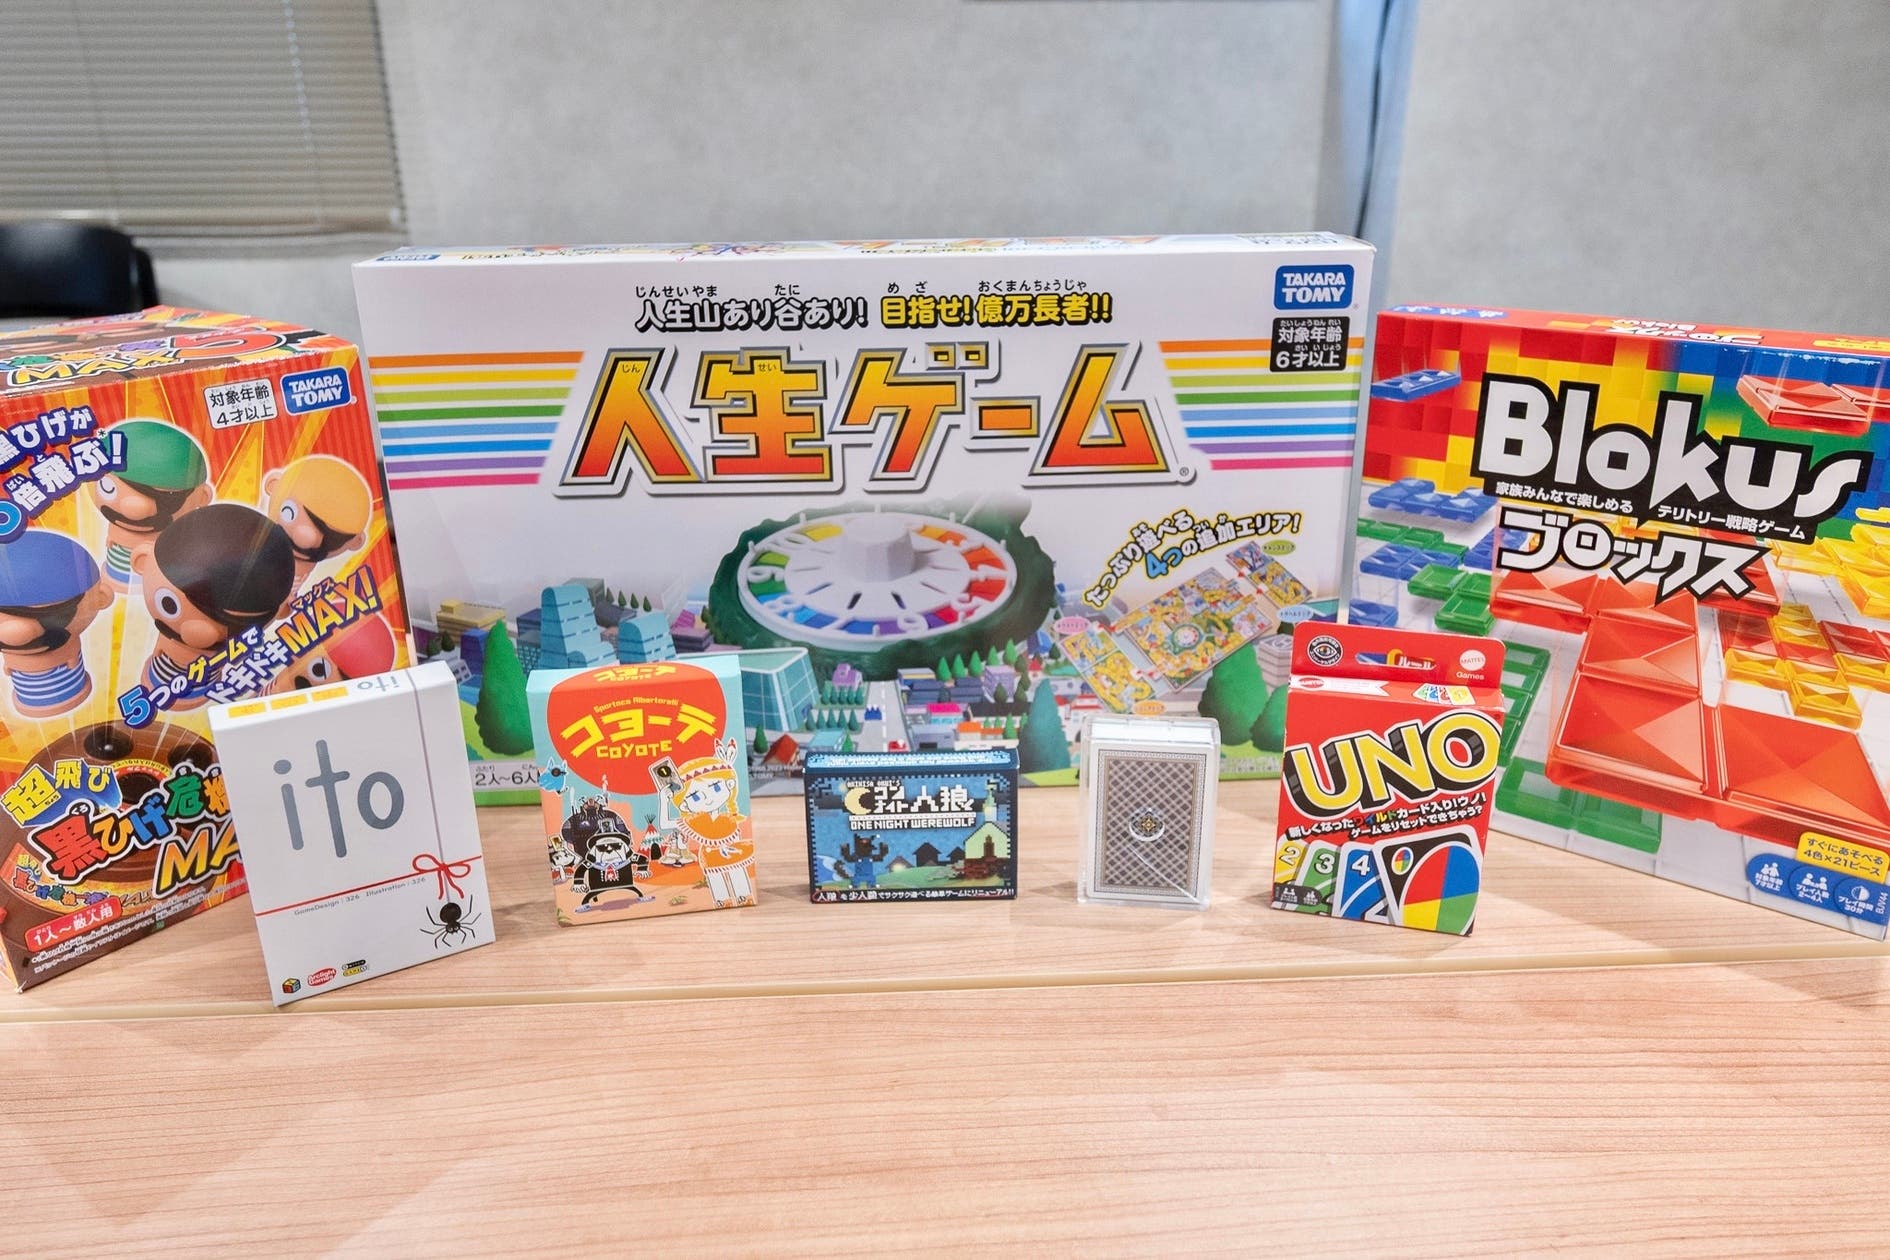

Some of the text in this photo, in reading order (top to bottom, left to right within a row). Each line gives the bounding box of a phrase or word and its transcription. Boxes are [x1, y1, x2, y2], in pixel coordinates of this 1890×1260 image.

[774, 283, 800, 296] たに
[887, 278, 1087, 294] め ざ おくまんちょうじゃ
[1282, 271, 1346, 287] TAKARA
[1282, 286, 1345, 303] TOMY
[1278, 326, 1342, 343] 対象年齢
[1275, 350, 1340, 368] 6才以上
[289, 374, 343, 393] TAKARA
[209, 385, 270, 408] 対象年齢
[292, 386, 343, 408] TOMY
[216, 404, 274, 426] 4才以上
[558, 341, 1171, 485] 人生ゲーム
[1478, 380, 1860, 518] Blokus
[1495, 480, 1806, 540] 家族みんなで楽しめる テリトリー戦略ゲーム
[1145, 512, 1302, 579] 4つの追加エリア!
[1500, 511, 1761, 598] ブロックス
[1085, 509, 1194, 607] たっぷり遊べる
[1456, 671, 1484, 680] Games
[560, 703, 716, 759] コヨーテ
[596, 740, 673, 759] COYOTE
[1285, 712, 1502, 812] UNO
[0, 758, 112, 826] 超飛び
[273, 739, 404, 858] ito
[910, 784, 975, 813] 人狼
[850, 817, 975, 830] ONE NIGHT WEREWOLF
[1279, 846, 1301, 866] 2
[1807, 838, 1884, 865] すぐにあそべる
[1314, 853, 1334, 874] 3
[1352, 854, 1371, 876] 4
[294, 899, 340, 916] GameDesign
[346, 894, 360, 903] 326
[366, 882, 405, 897] Illustration
